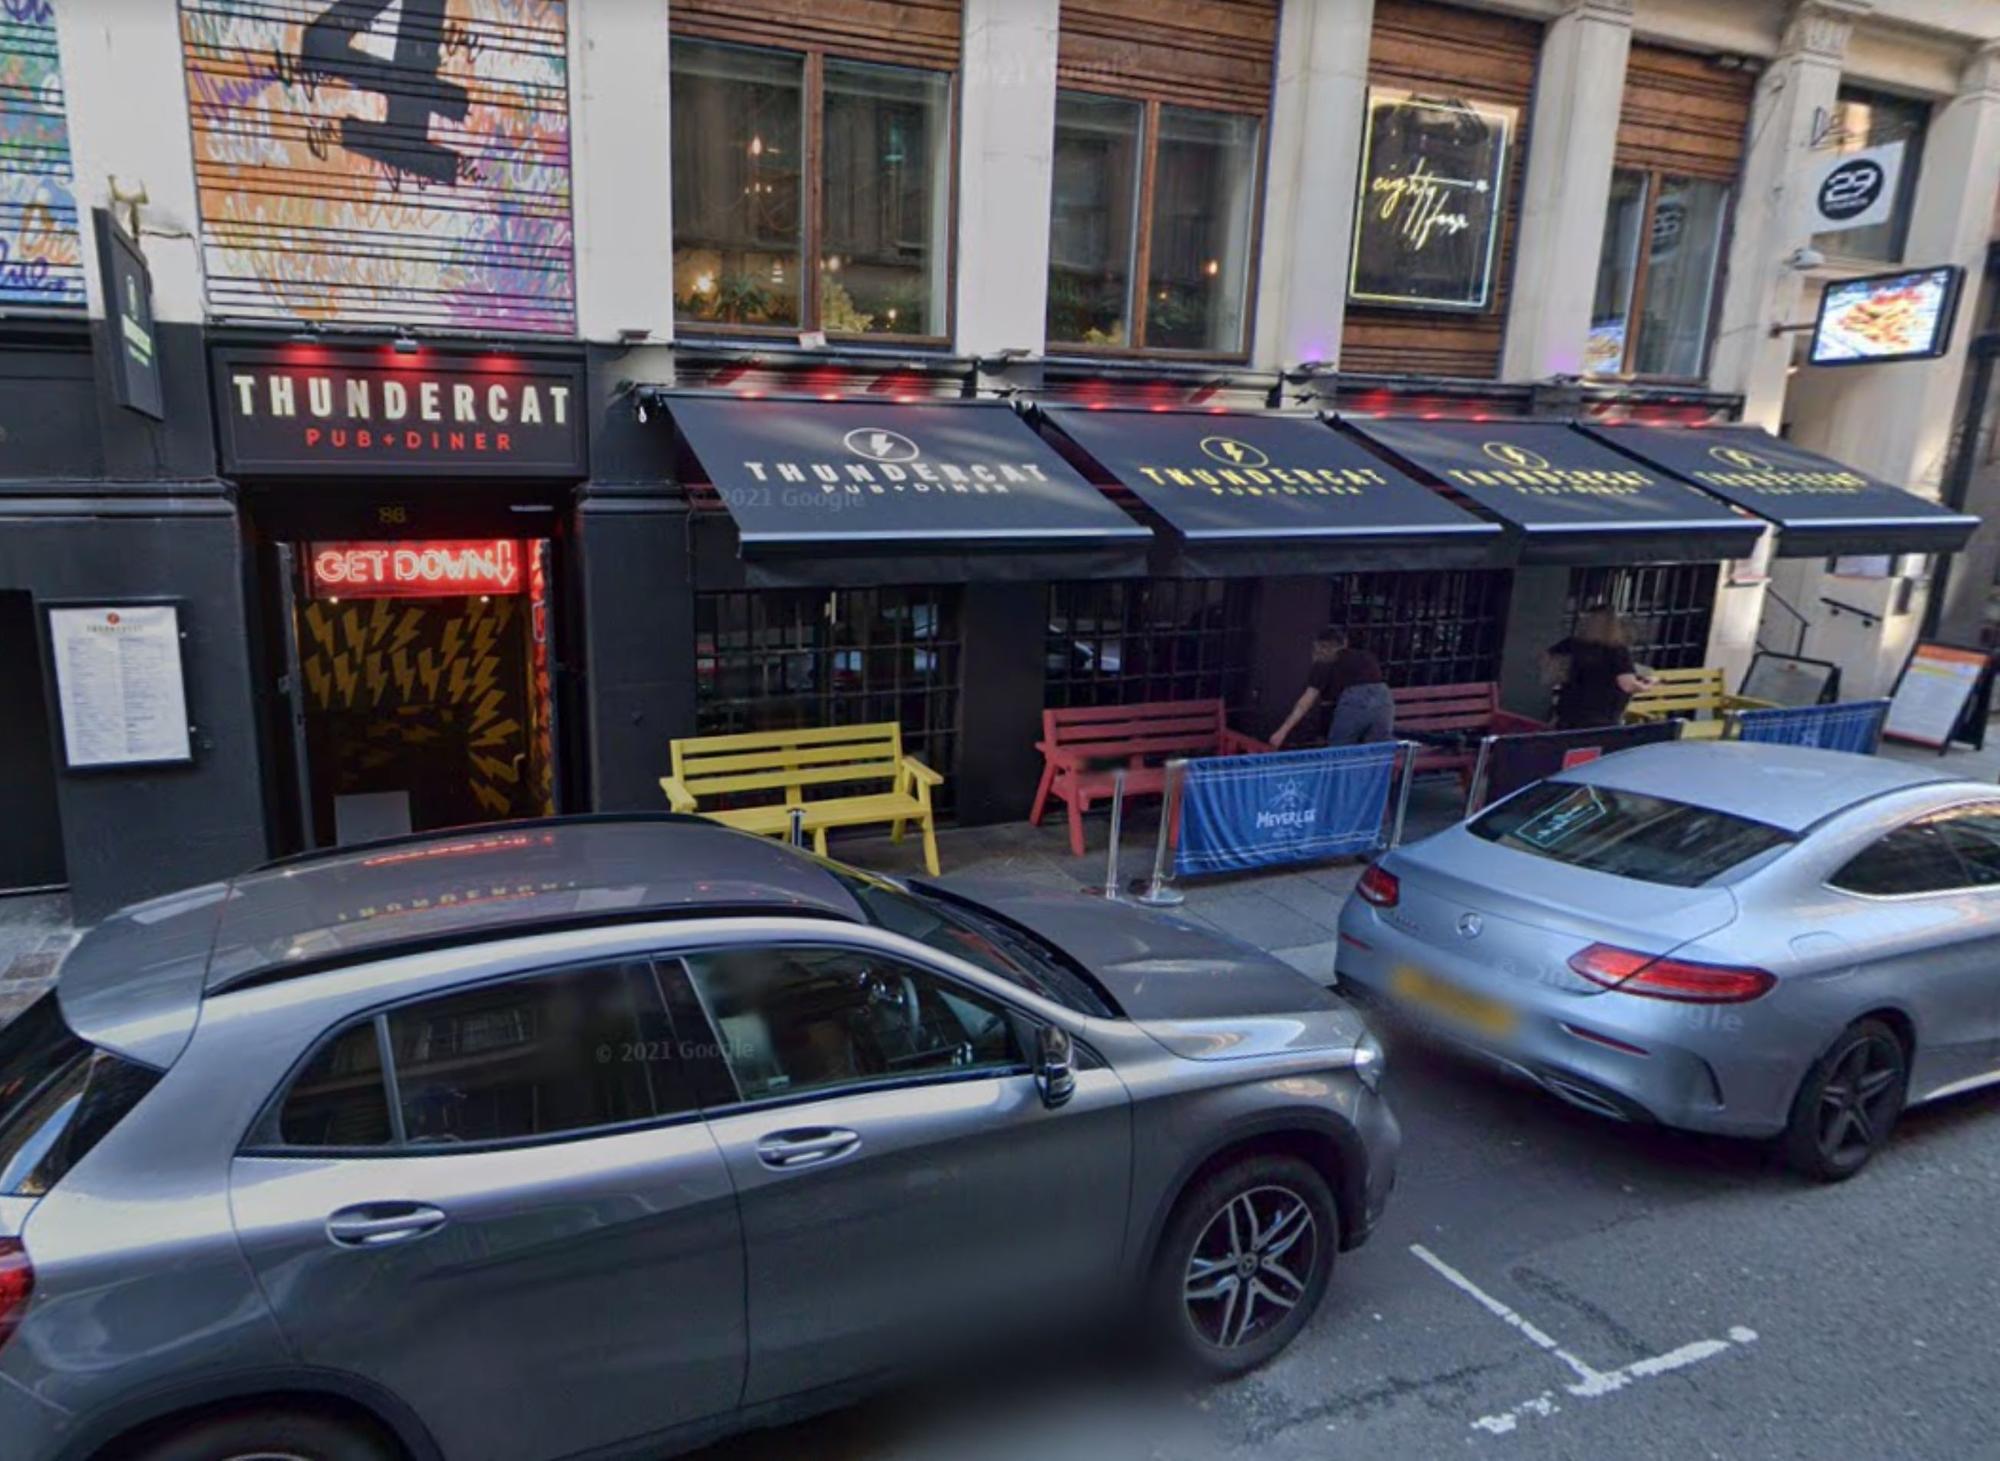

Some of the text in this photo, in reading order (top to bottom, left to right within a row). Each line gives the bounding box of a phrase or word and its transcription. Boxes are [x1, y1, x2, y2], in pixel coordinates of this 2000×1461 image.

[1825, 167, 1878, 202] 29
[233, 375, 569, 424] THUNDERCAT
[744, 461, 1049, 483] THUNDERCAT
[1139, 467, 1388, 486] THUNDERCAT
[314, 549, 389, 582] GET
